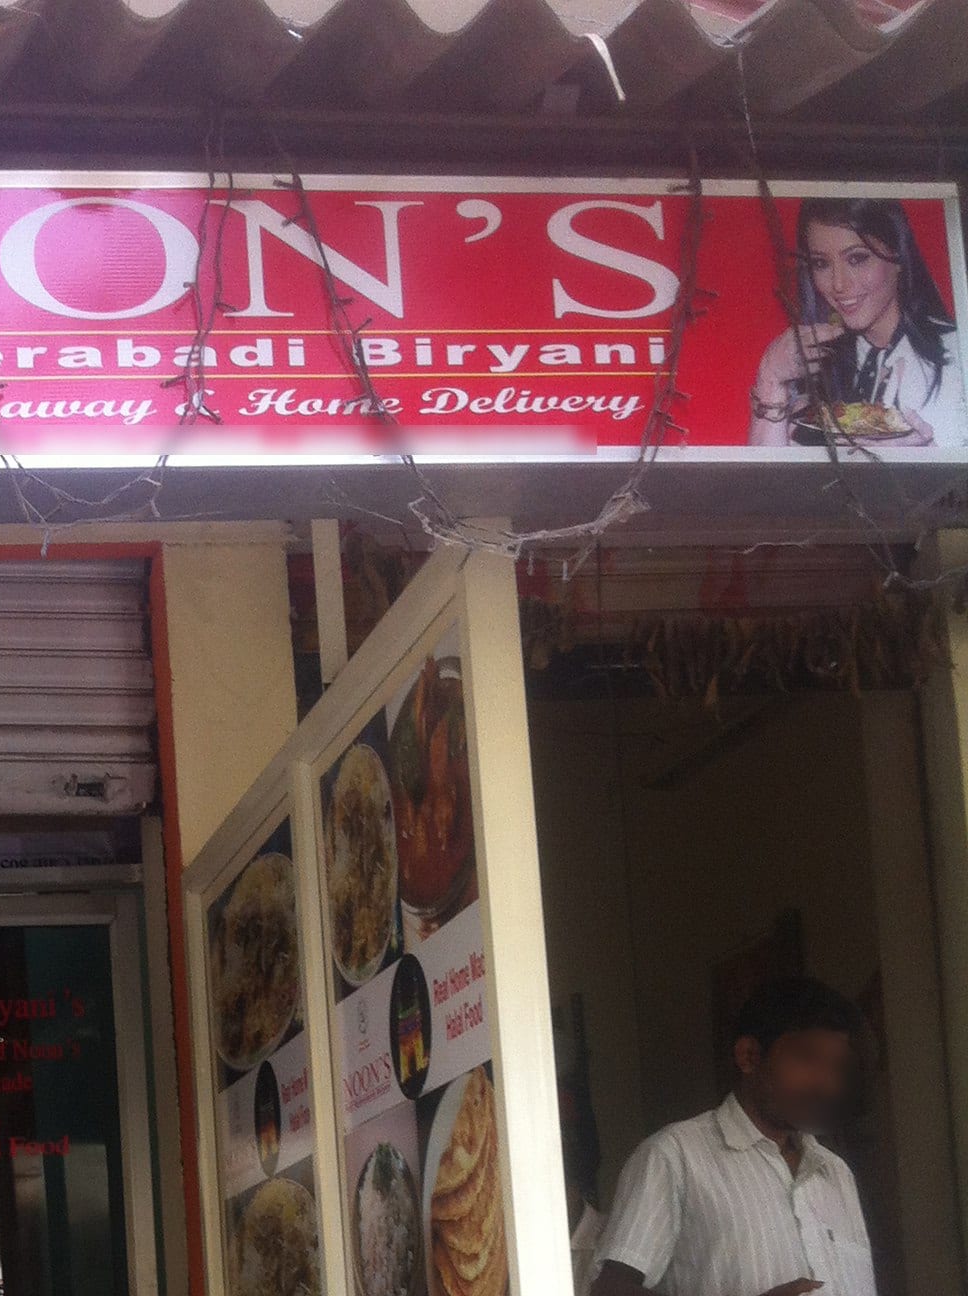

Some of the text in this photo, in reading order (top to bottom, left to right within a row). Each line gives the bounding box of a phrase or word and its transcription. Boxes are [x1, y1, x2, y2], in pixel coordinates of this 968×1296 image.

[365, 337, 666, 374] Biryani
[239, 388, 403, 415] Home
[419, 387, 645, 420] Delivery
[9, 1136, 70, 1158] Food
